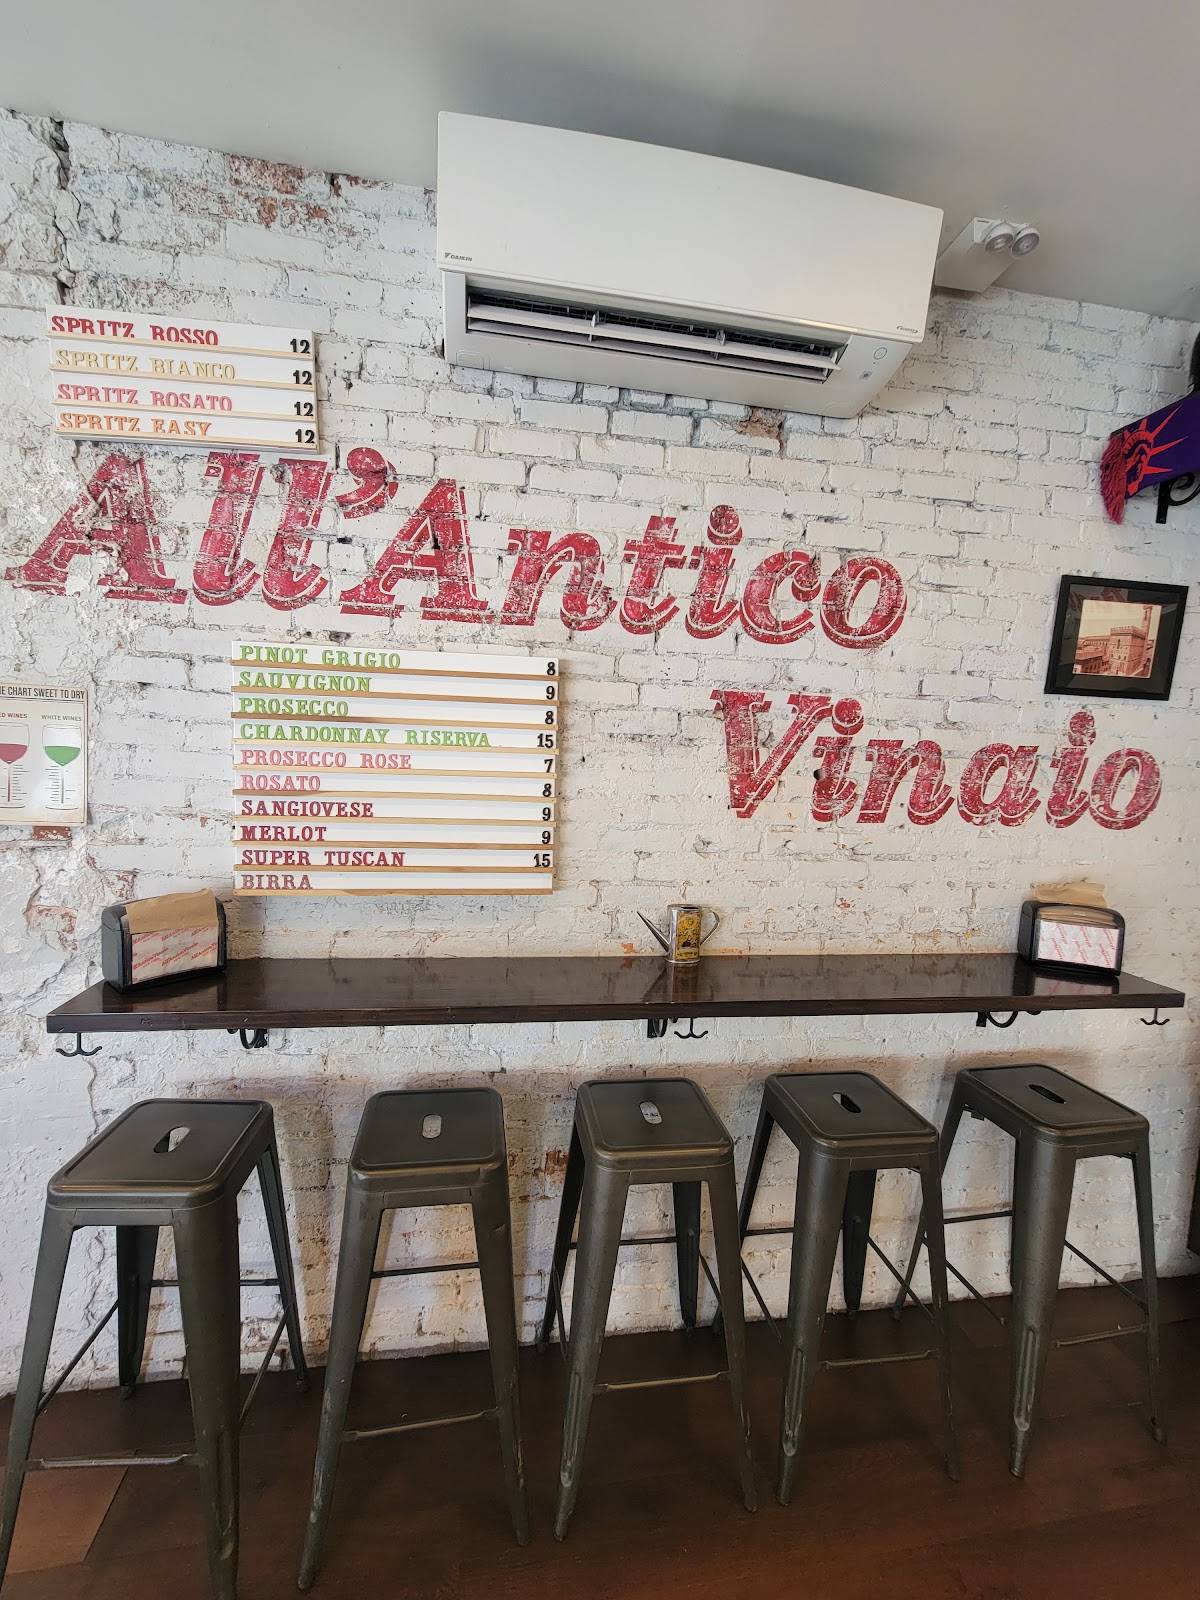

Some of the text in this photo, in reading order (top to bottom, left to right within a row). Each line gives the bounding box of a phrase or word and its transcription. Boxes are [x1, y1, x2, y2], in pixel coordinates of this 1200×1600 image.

[51, 316, 311, 354] SPRITZ ROSSO 12
[55, 349, 312, 385] SPRITZ BIANCO 12
[57, 384, 314, 417] SPRITZ ROSATO 12
[59, 412, 315, 444] SPRITZ EASY 12
[240, 645, 556, 676] PINOT GRIGIO 8
[8, 686, 32, 697] CHART
[34, 688, 58, 698] SWEET
[60, 690, 69, 699] TO
[71, 690, 85, 699] DRY
[239, 671, 555, 700] SAUVIGNON 9
[239, 697, 554, 725] PROSECCO 8
[240, 724, 554, 748] CHARDONNAY RISERVA 15
[241, 750, 554, 773] PROSECCO ROSE 7
[710, 689, 1162, 830] Vinaio
[241, 774, 552, 798] ROSATO 8
[241, 800, 551, 822] SANGIOVESE 9
[241, 826, 551, 845] MERLOT 9
[241, 850, 550, 868] SUPER TUSCAN 15
[241, 874, 313, 890] BIRRA
